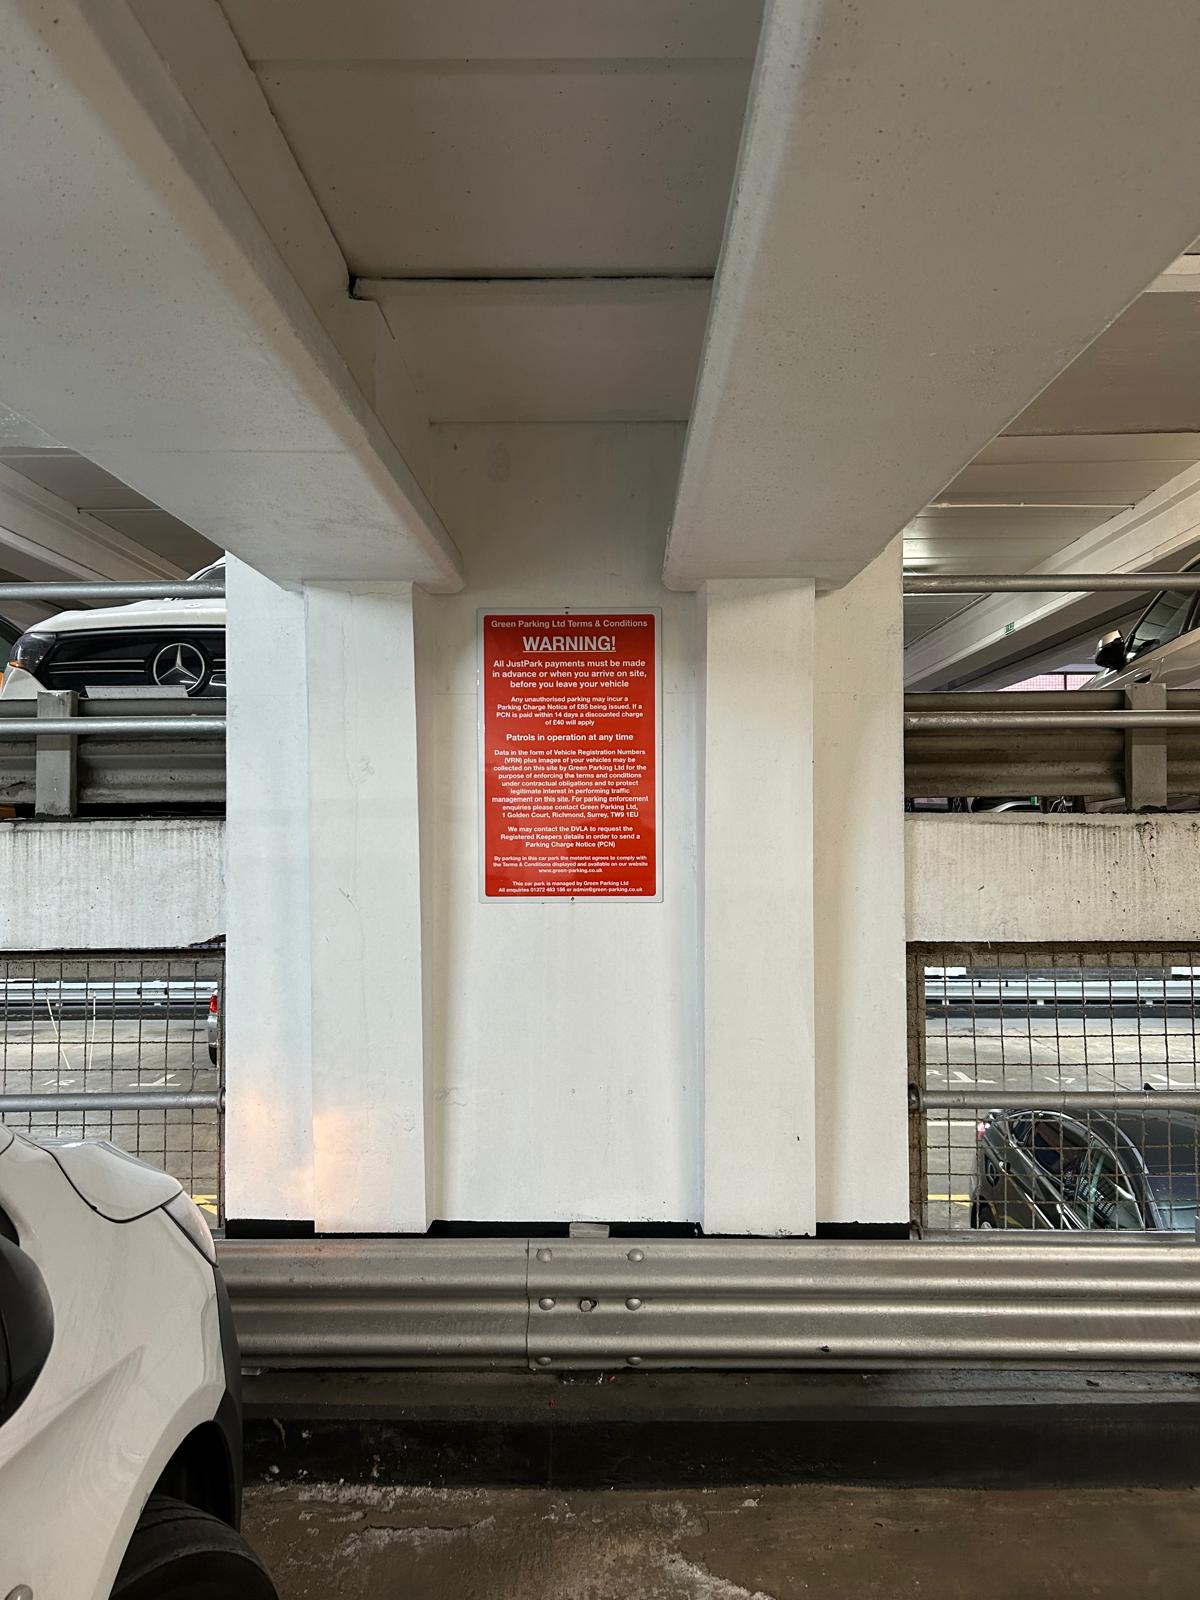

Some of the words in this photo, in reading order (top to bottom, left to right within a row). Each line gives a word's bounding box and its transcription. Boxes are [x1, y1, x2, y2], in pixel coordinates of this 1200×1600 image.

[518, 620, 550, 628] Parking
[522, 636, 616, 652] WARNING!
[545, 660, 585, 668] payments
[629, 670, 646, 678] site,
[547, 734, 586, 742] operation
[504, 757, 522, 765] (VRN)
[519, 825, 532, 833] may
